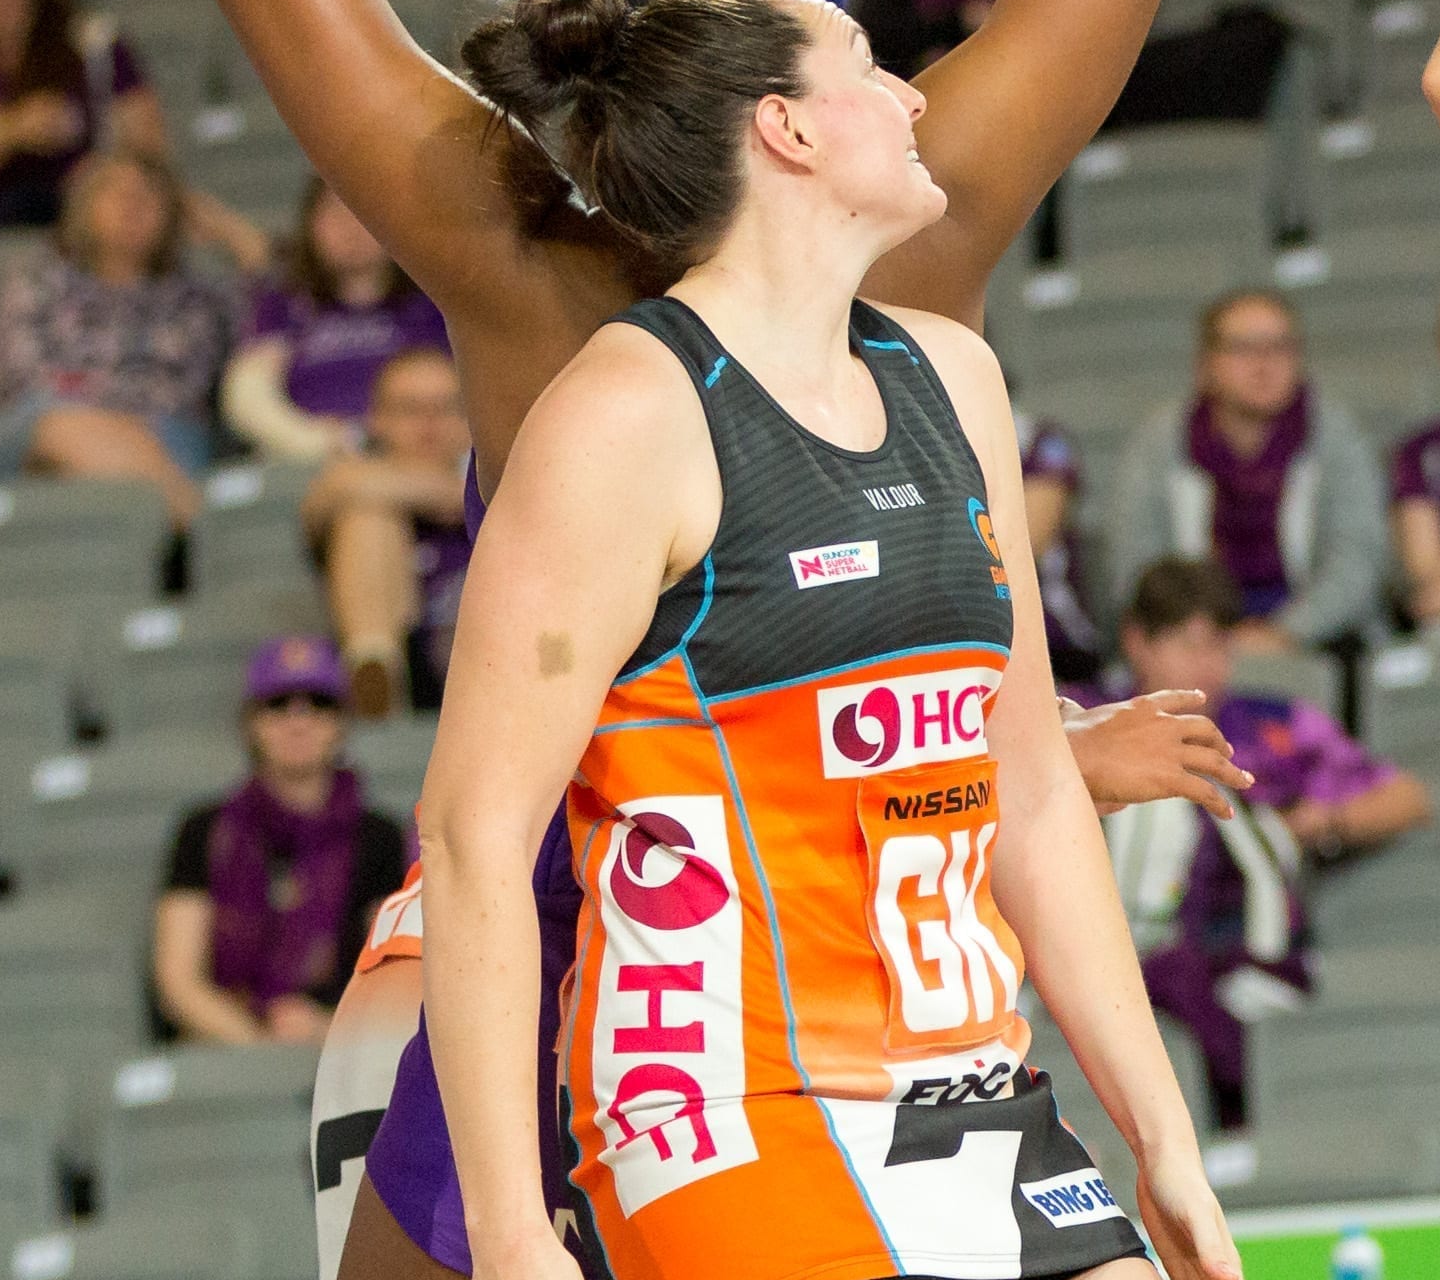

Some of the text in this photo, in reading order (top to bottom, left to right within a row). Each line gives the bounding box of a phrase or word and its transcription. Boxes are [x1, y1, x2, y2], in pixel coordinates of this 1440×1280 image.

[863, 483, 925, 511] VALOUR
[822, 547, 861, 561] SUNCORP
[826, 557, 855, 569] SUPER
[827, 564, 870, 577] NETBALL
[912, 685, 991, 748] HC
[884, 780, 990, 820] NISSAN
[872, 822, 1017, 1033] GK
[1031, 1182, 1095, 1218] BING
